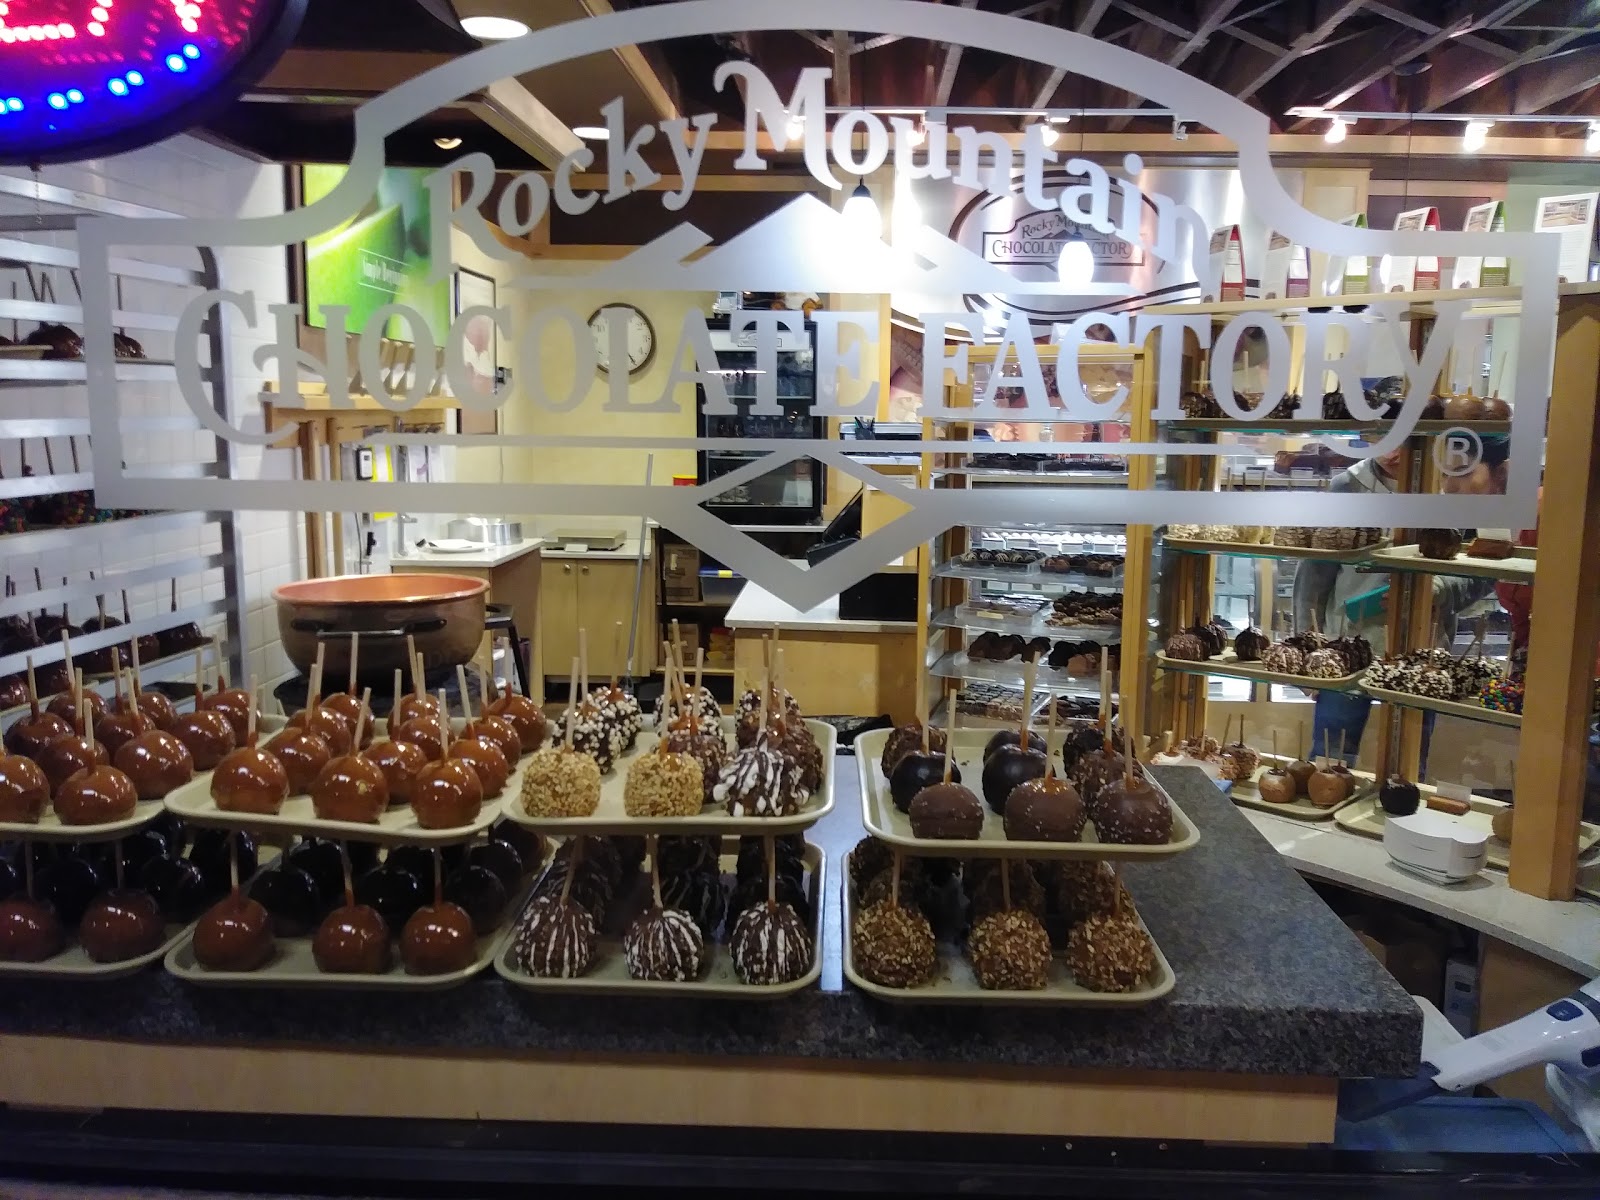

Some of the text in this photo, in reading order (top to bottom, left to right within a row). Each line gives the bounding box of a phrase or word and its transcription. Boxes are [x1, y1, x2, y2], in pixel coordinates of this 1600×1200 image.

[423, 60, 1211, 290] Rocky Mountain
[992, 239, 1065, 258] CHOCOLAT
[1022, 217, 1056, 239] Rocky
[174, 290, 881, 446] CHOCOLATE
[917, 300, 1470, 459] FACTORY
